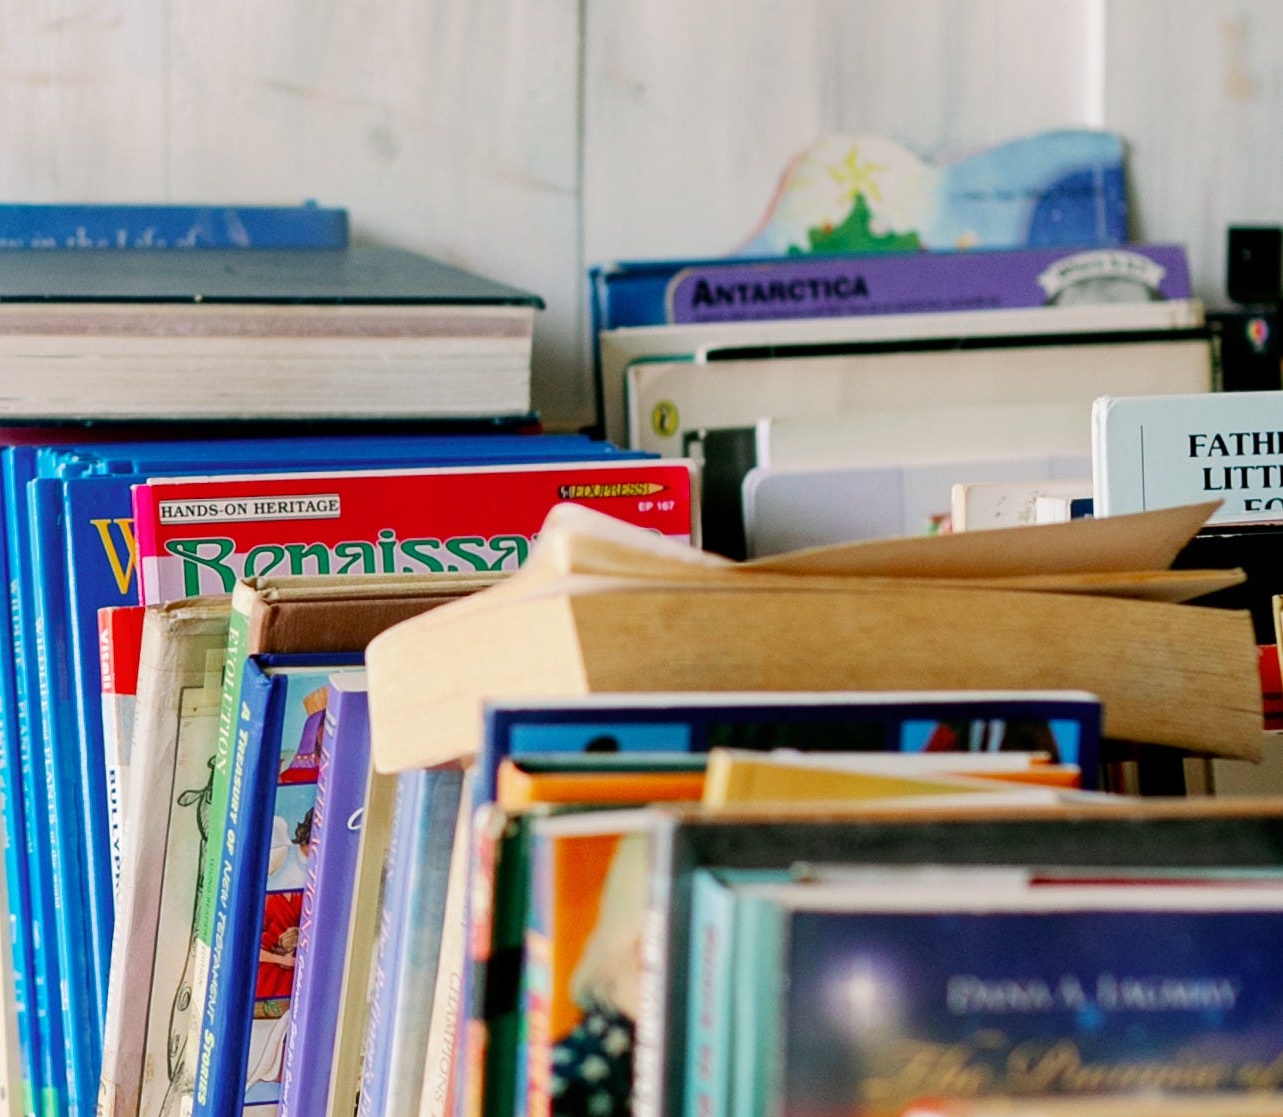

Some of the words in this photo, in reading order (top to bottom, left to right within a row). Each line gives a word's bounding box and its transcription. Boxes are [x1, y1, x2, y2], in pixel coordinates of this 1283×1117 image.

[692, 276, 868, 306] ANTARCTICA
[161, 502, 247, 518] HANDS-ON
[254, 499, 339, 516] HERITAGE
[638, 501, 653, 511] EP
[657, 500, 675, 511] 167
[1203, 465, 1283, 490] LITT
[164, 529, 538, 597] Renaissa
[35, 616, 49, 713] WILDLIFE
[44, 746, 58, 824] PLANTS
[217, 626, 240, 775] EVOLUTION
[241, 701, 251, 720] A
[18, 702, 31, 773] PLANTS
[229, 728, 248, 824] TREASURY
[225, 829, 235, 857] OF
[299, 746, 331, 953] INTERACTIONS
[219, 860, 233, 908] NEW
[206, 911, 227, 1026] TESTAMENT
[197, 1028, 216, 1106] STORIES
[434, 970, 460, 1103] CHAMPIONS
